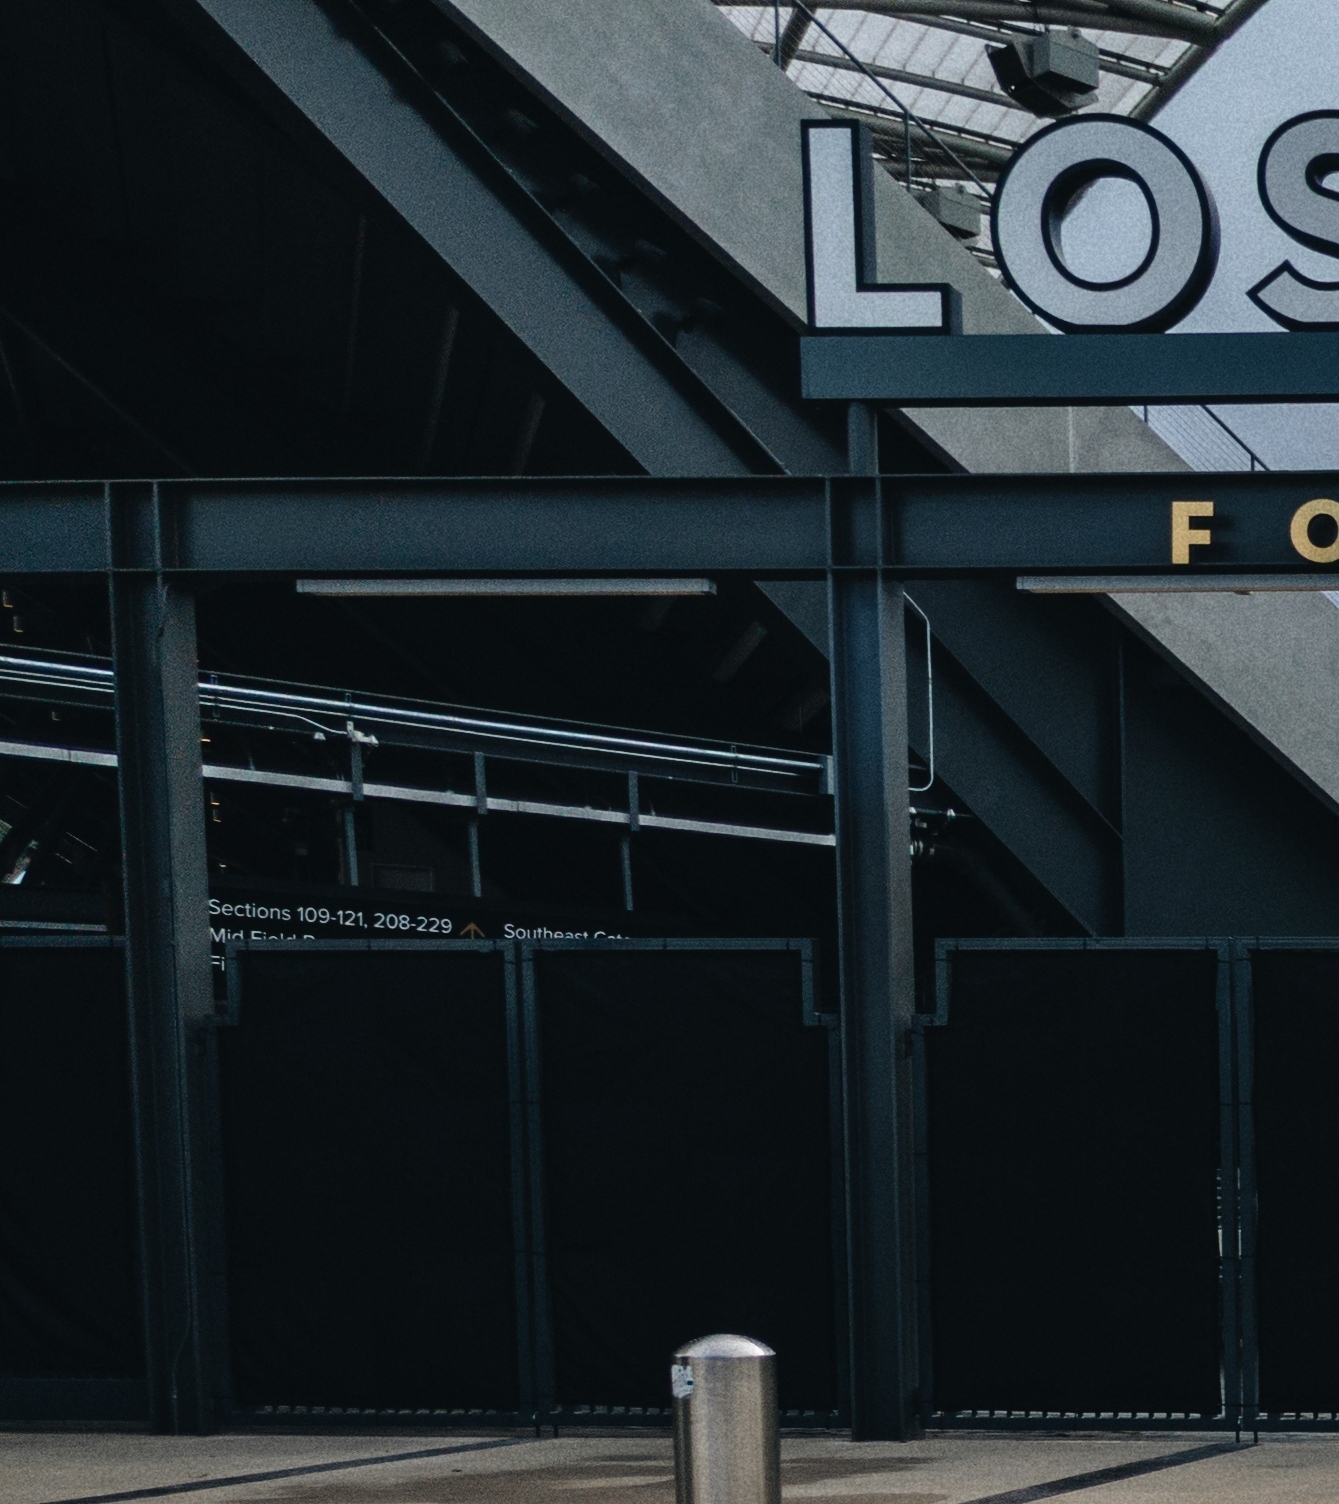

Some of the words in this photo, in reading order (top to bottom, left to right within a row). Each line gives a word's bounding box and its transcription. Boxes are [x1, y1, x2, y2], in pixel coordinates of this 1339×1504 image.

[208, 898, 291, 921] Sections
[297, 906, 368, 929] 109-121,
[374, 912, 453, 935] 208-229
